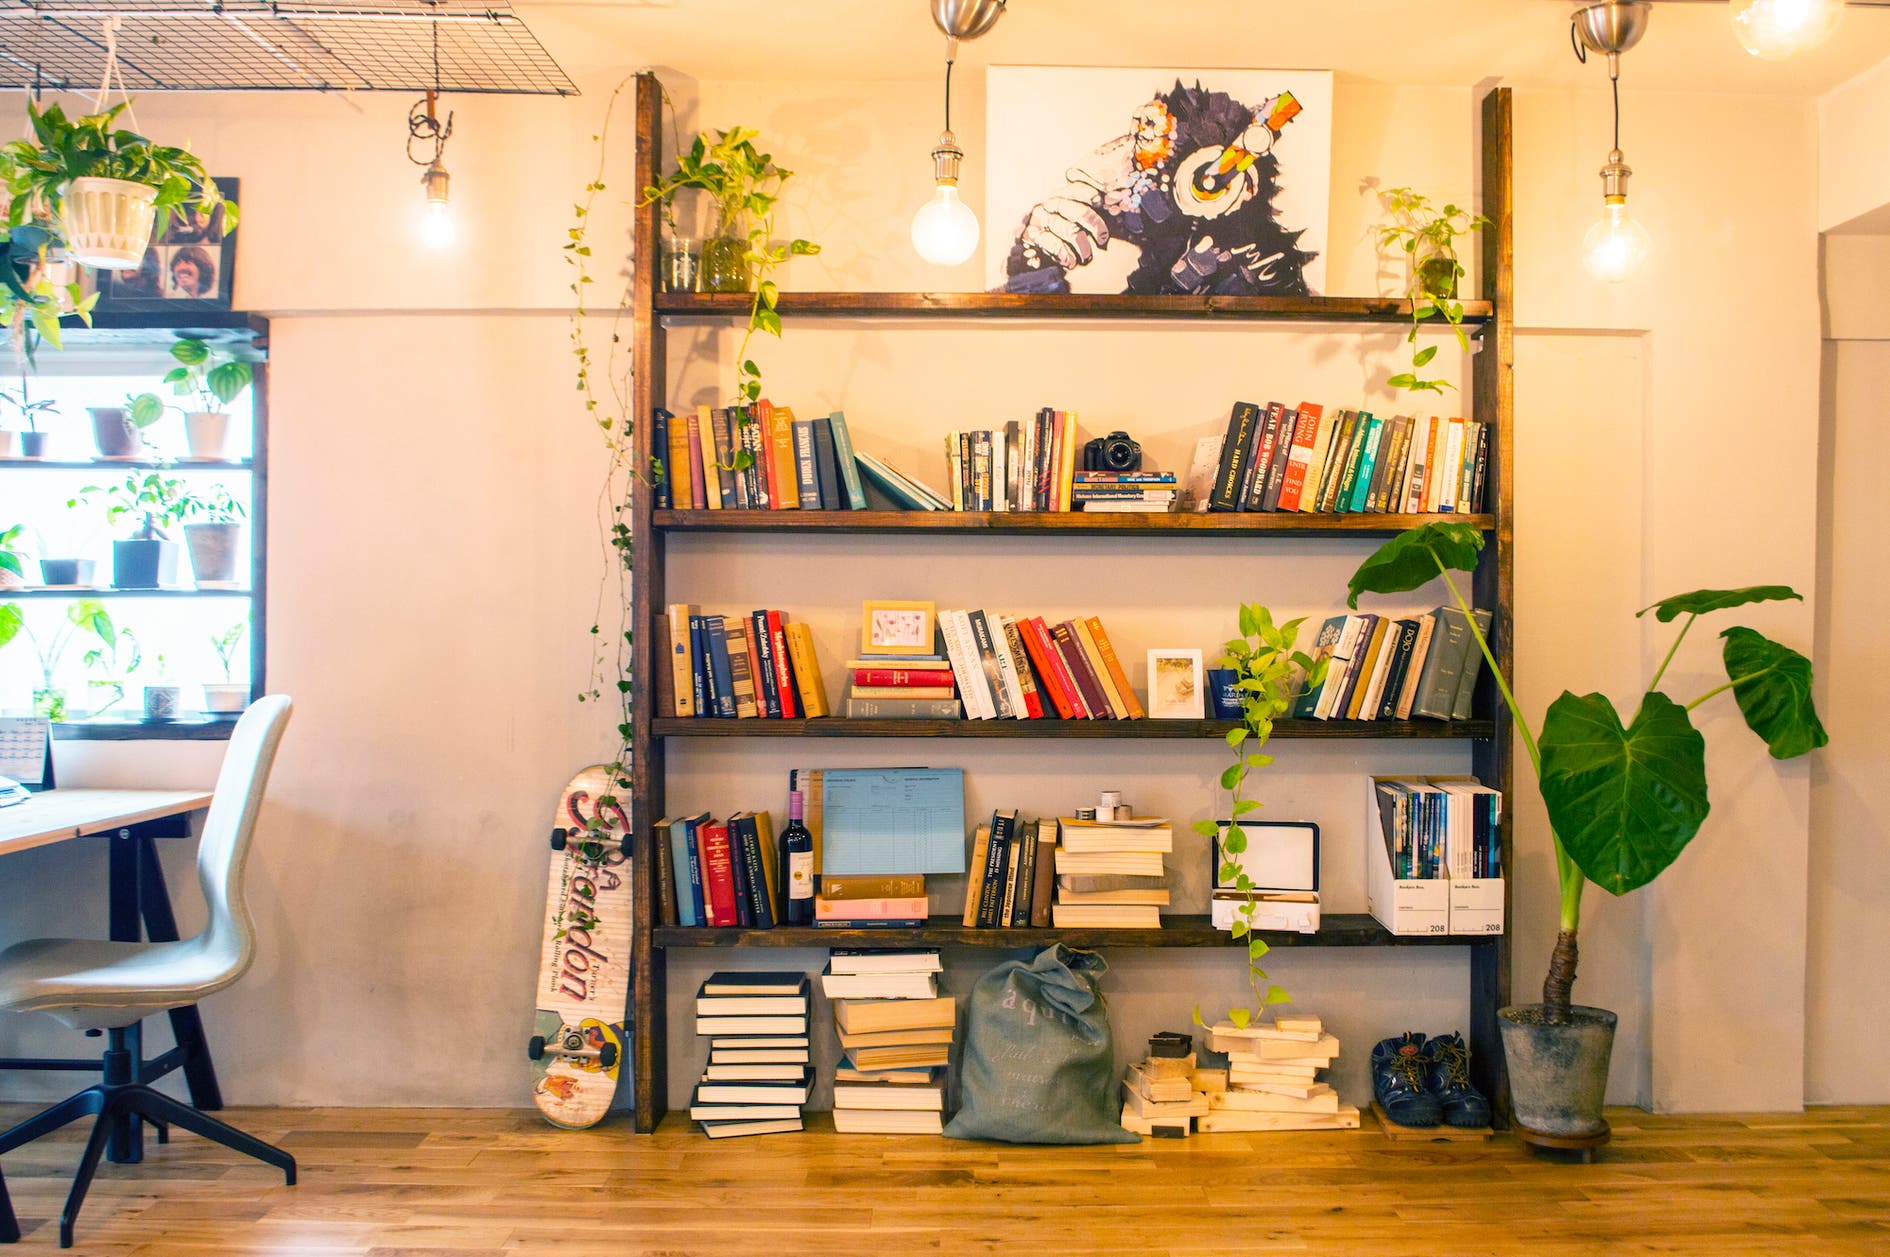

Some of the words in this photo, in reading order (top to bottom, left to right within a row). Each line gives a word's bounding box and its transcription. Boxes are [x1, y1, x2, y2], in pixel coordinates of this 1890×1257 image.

[1267, 406, 1279, 430] FEAR
[1295, 410, 1309, 443] IRVING
[1305, 416, 1316, 442] JOHN
[752, 424, 761, 451] SATAN
[1264, 433, 1273, 450] BOB
[801, 460, 813, 484] DUDEN
[1232, 448, 1241, 469] HARD
[1225, 469, 1236, 498] CHOICES
[1253, 452, 1270, 494] WOODWARD
[1286, 478, 1302, 486] FIND
[975, 619, 988, 648] MURAKAMI
[1402, 629, 1415, 651] DOJO
[966, 639, 979, 670] ANNAN
[1006, 623, 1026, 674] INVESTMENTS
[989, 880, 998, 907] PATTERSON
[552, 940, 562, 968] Rolling
